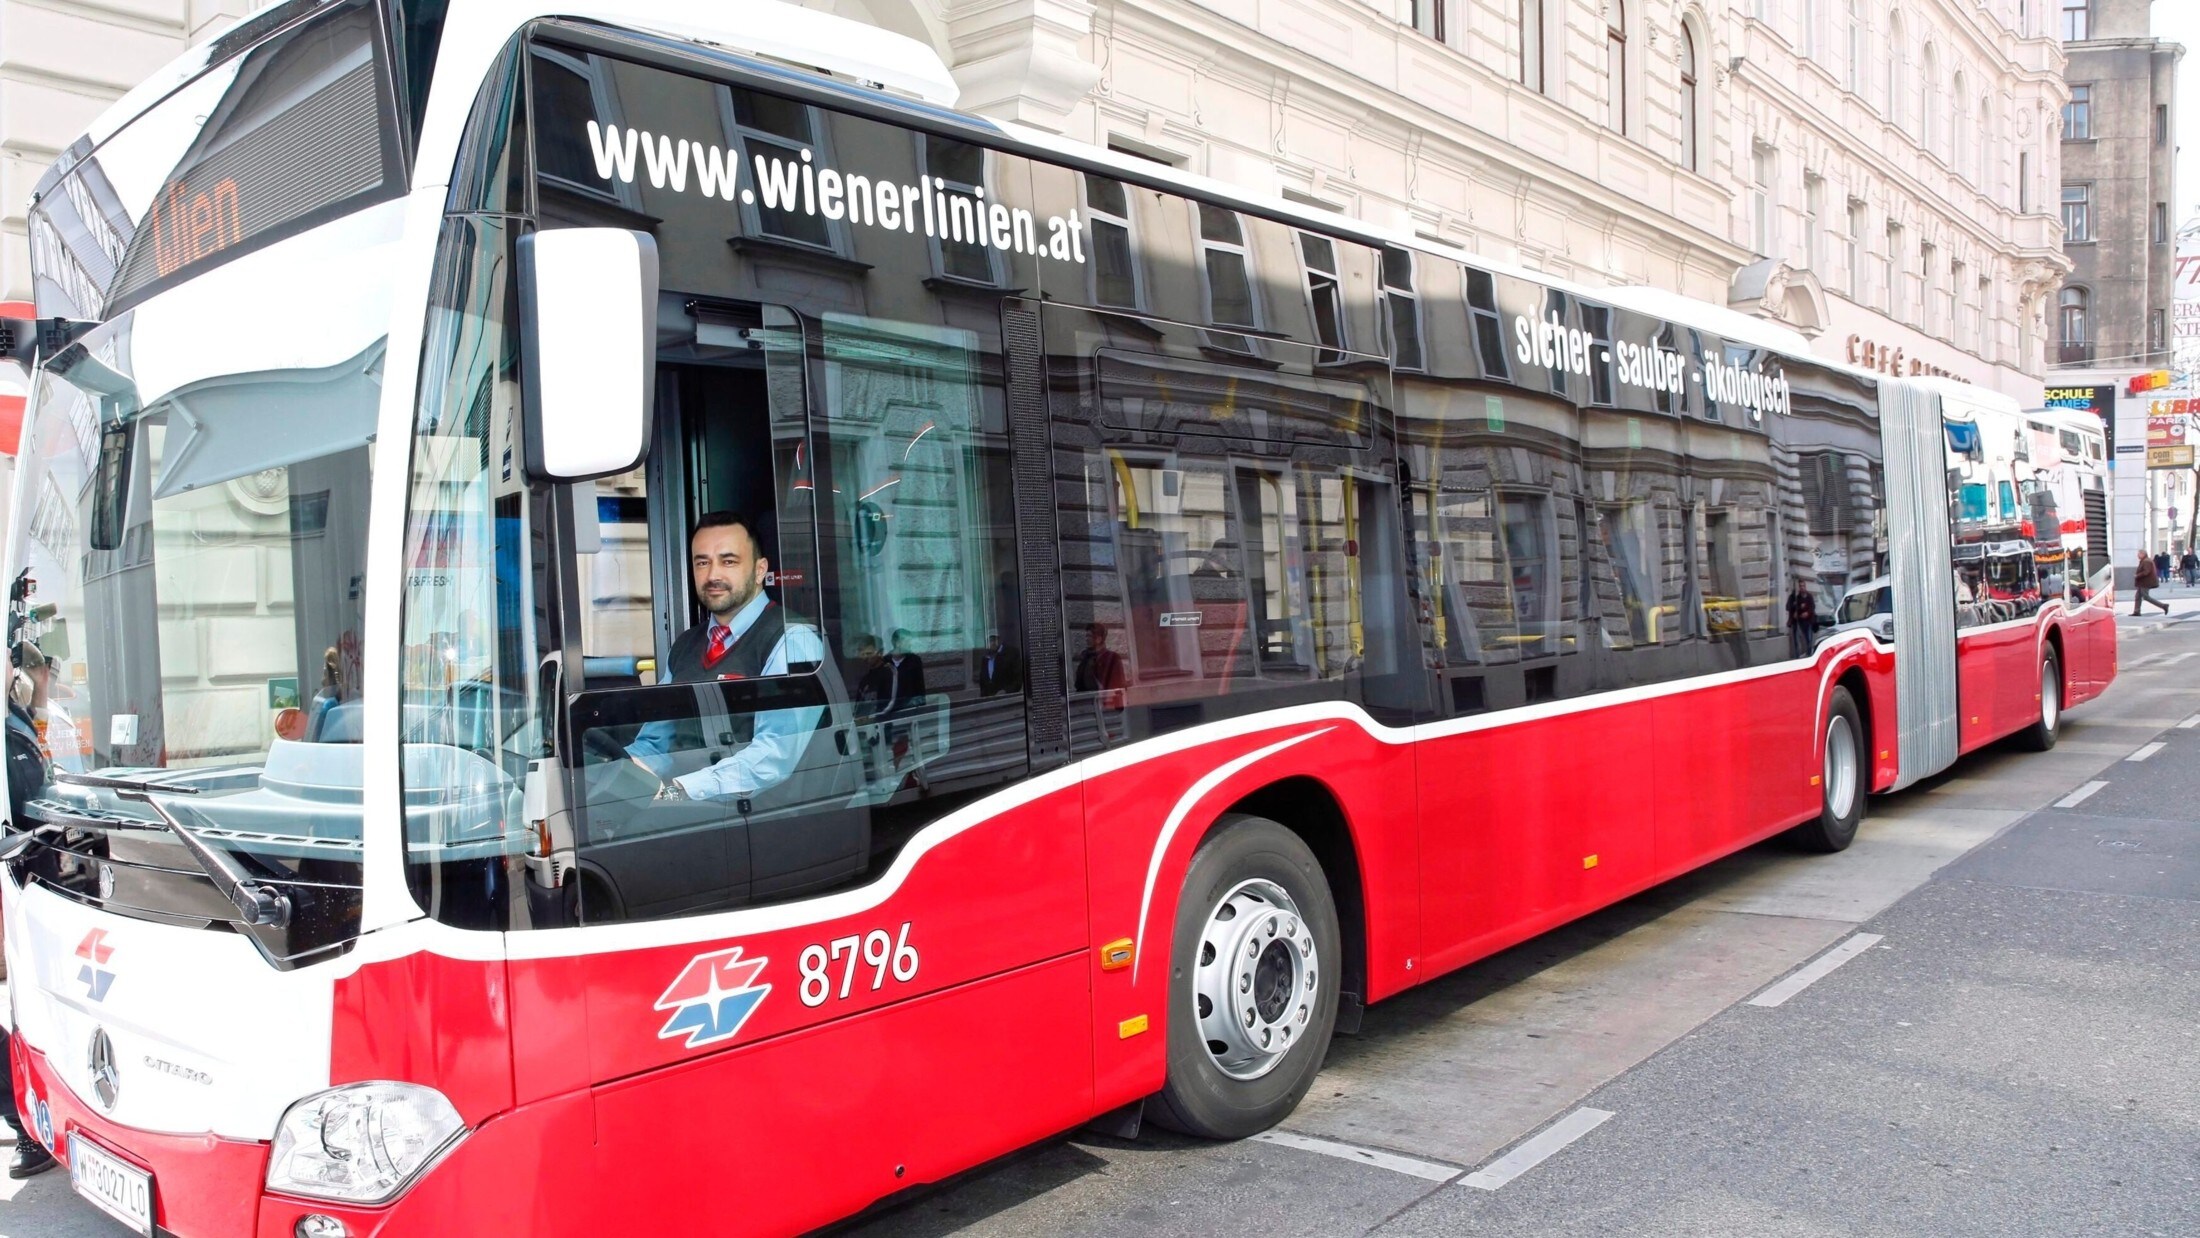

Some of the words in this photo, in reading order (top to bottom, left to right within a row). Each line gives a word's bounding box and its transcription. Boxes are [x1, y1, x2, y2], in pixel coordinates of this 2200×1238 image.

[587, 120, 1086, 264] www.wienerlinien.at
[1515, 304, 1593, 377] sicher
[1616, 336, 1686, 395] sauber
[1705, 350, 1791, 422] ökologisch
[1846, 333, 1904, 377] CAFÉ
[2044, 388, 2094, 399] SCHULE
[2045, 399, 2091, 409] GAMES
[798, 921, 919, 1008] 8796
